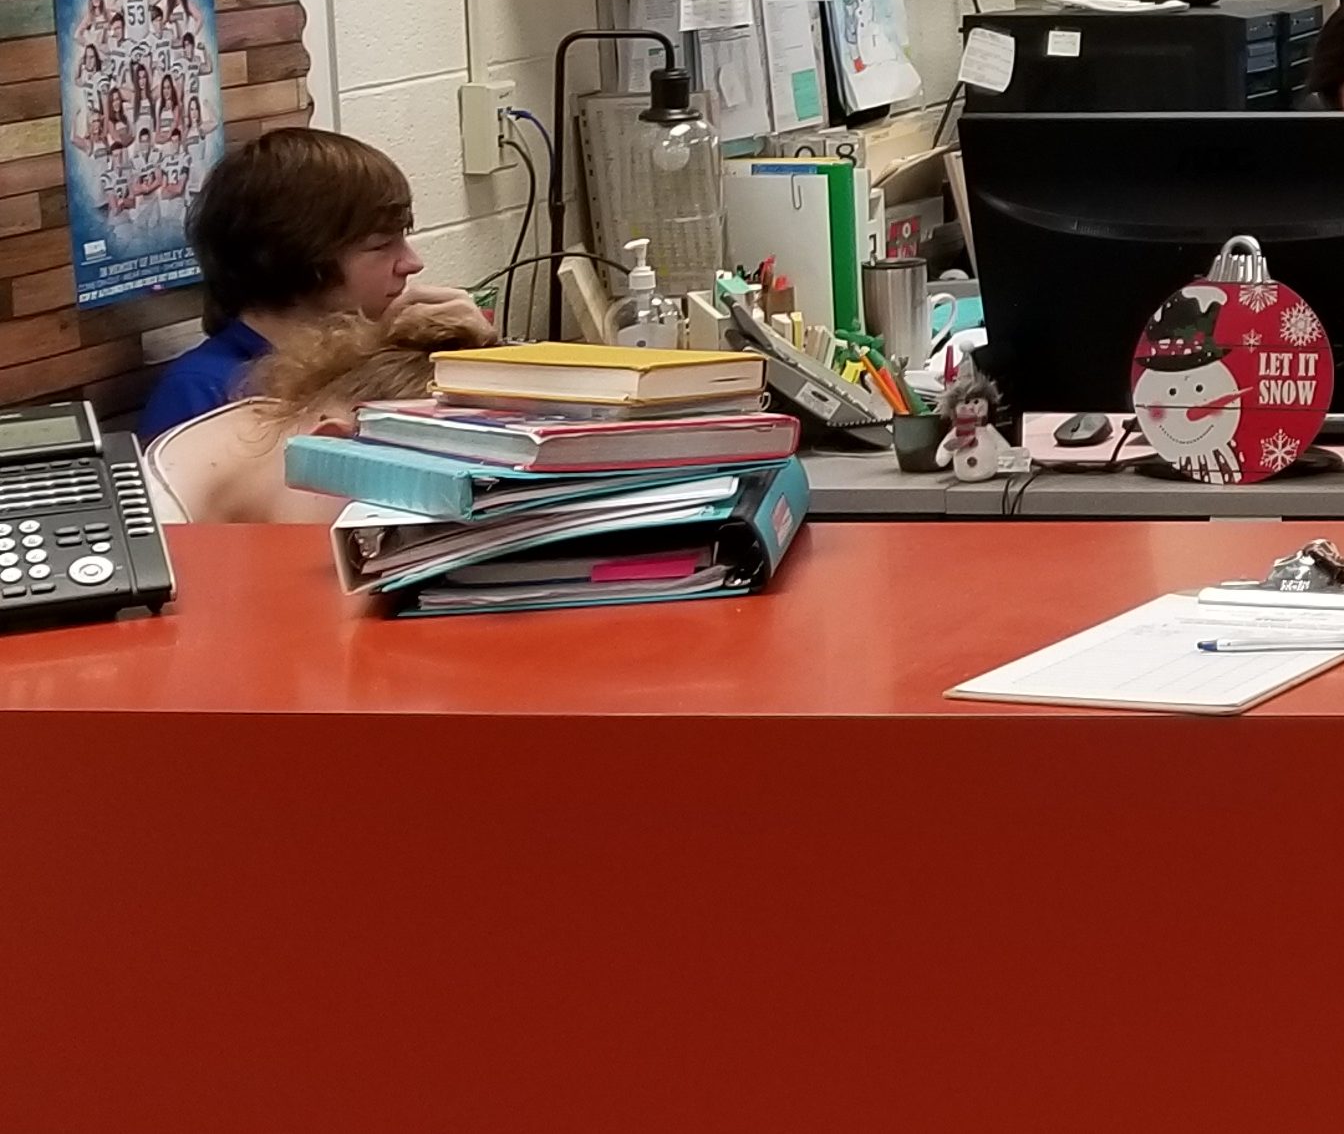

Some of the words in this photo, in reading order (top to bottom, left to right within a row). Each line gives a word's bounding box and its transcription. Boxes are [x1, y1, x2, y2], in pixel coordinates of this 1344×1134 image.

[127, 5, 146, 26] 53
[1259, 352, 1293, 376] LET
[1298, 352, 1319, 376] IT
[1259, 379, 1317, 406] SNOW
